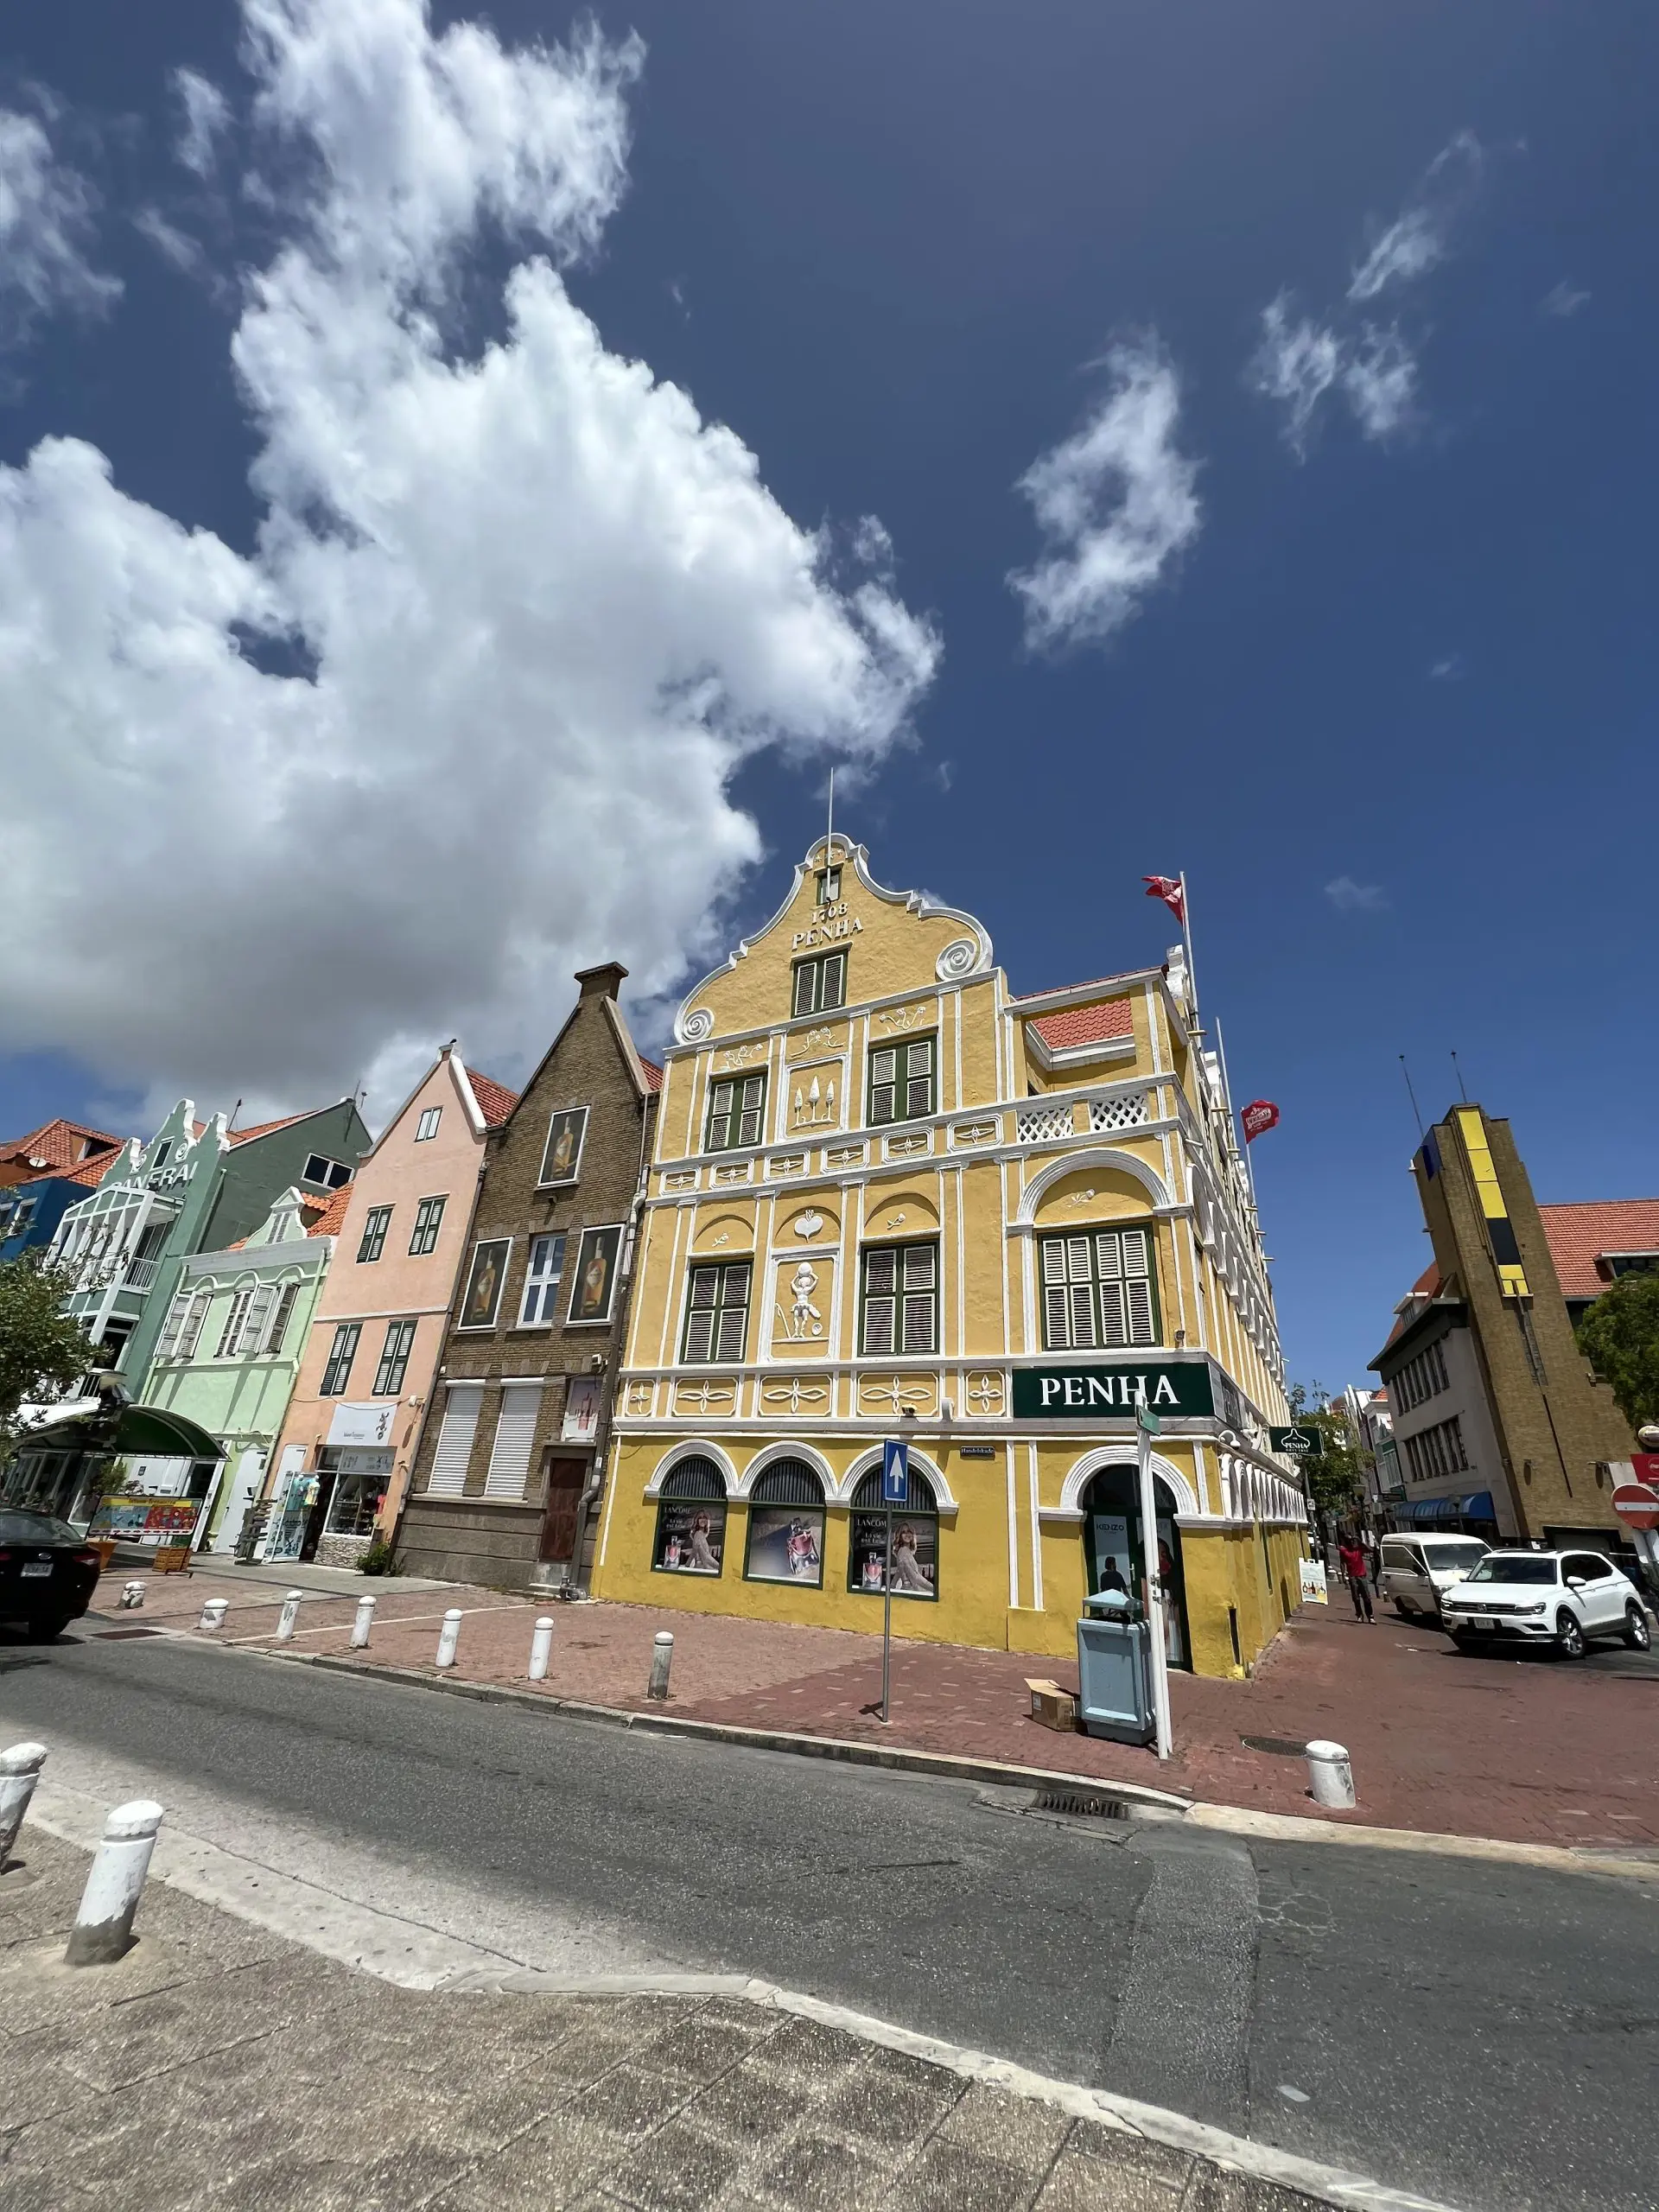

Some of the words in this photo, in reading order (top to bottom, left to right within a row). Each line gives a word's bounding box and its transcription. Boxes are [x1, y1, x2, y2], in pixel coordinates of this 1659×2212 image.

[812, 902, 848, 924] 1708
[792, 917, 863, 950] PENHA
[1039, 1375, 1181, 1406] PENHA
